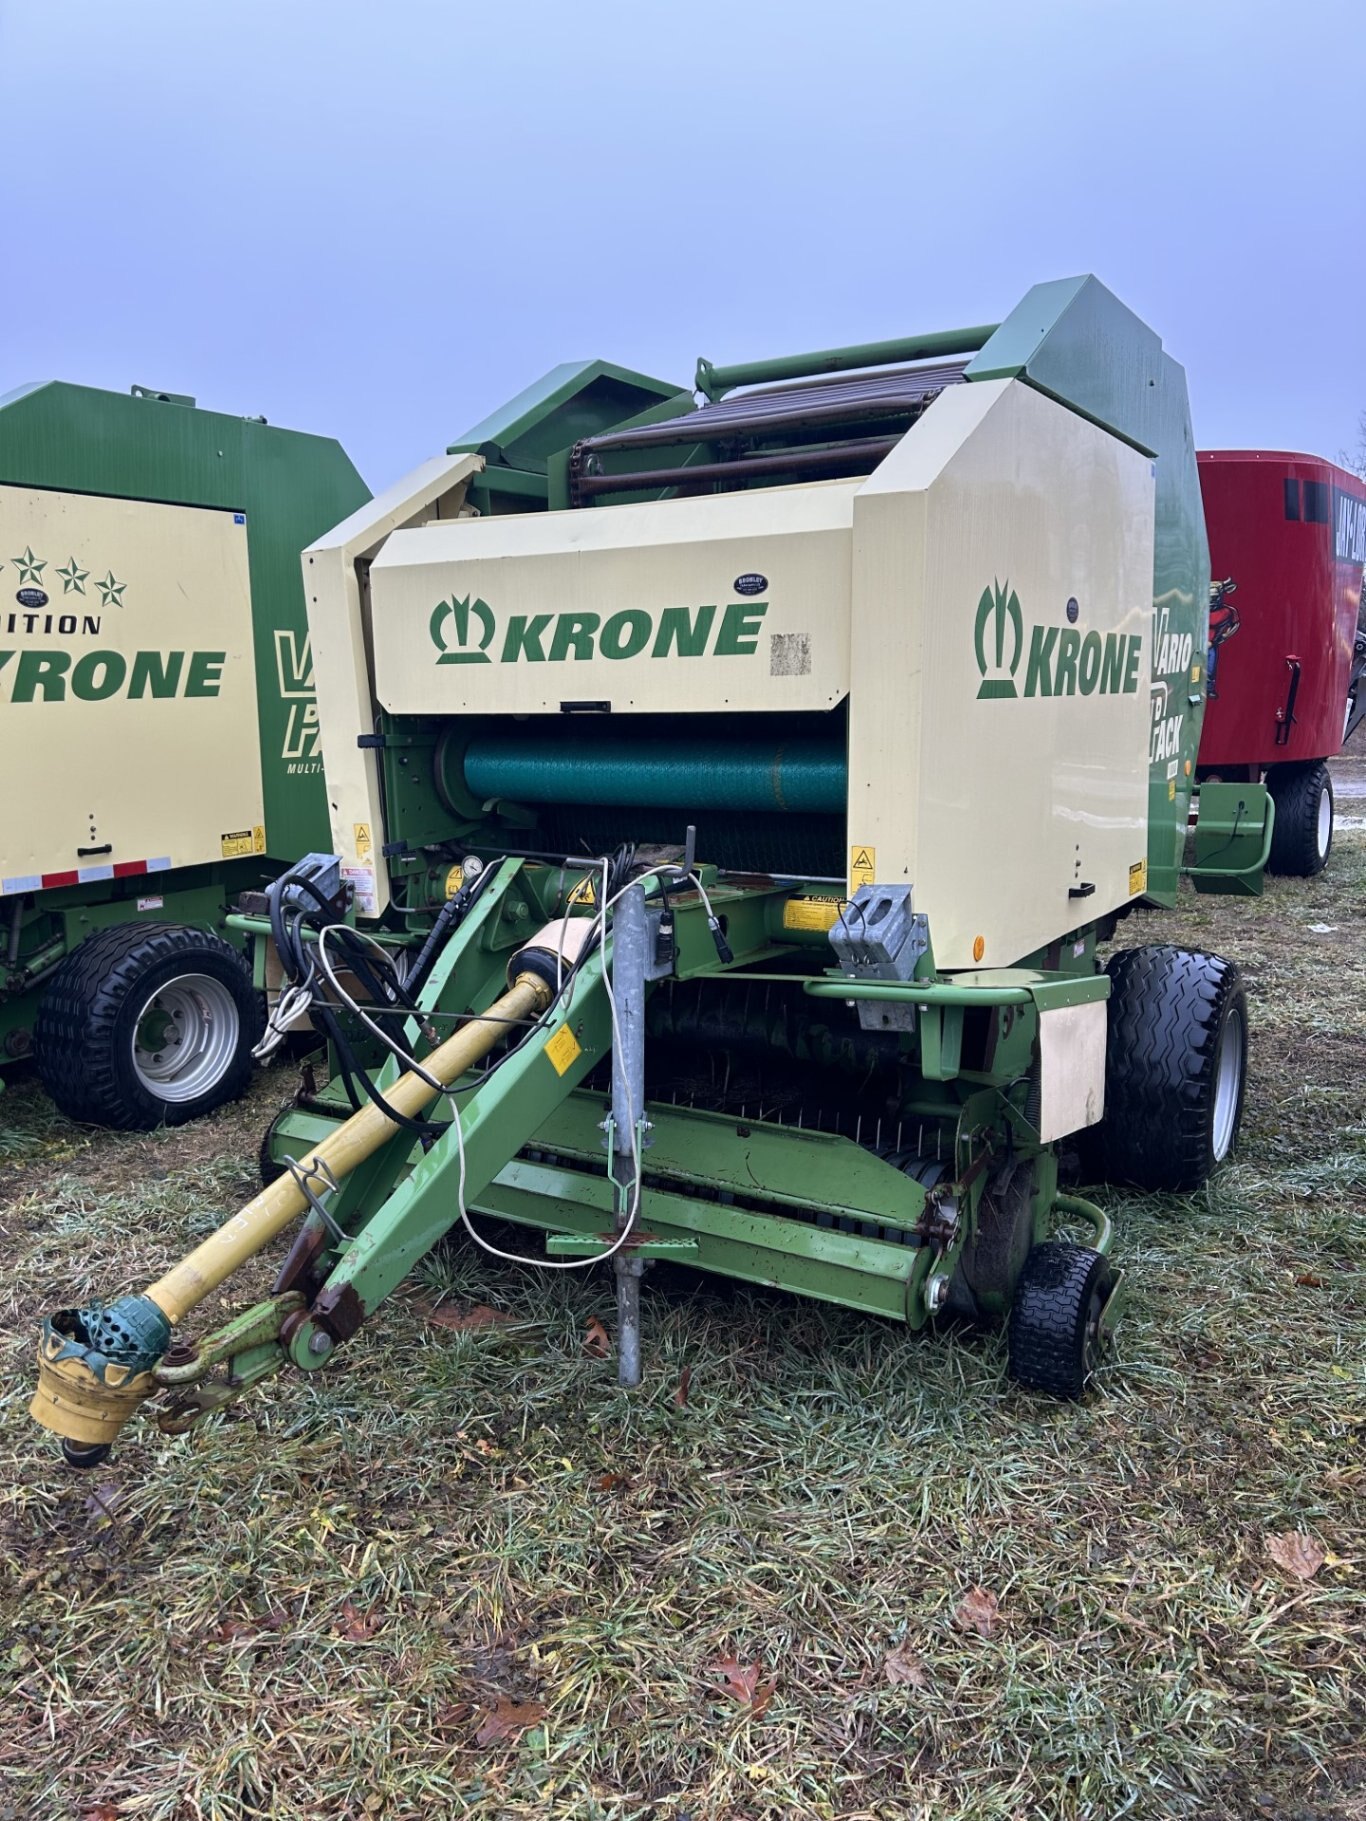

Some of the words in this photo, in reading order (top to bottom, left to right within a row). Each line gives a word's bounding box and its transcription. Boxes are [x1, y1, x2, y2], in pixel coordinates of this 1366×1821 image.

[0, 613, 101, 635] ITION
[501, 602, 769, 663] KRONE
[0, 650, 226, 703] RONE
[1023, 624, 1142, 698] KRONE
